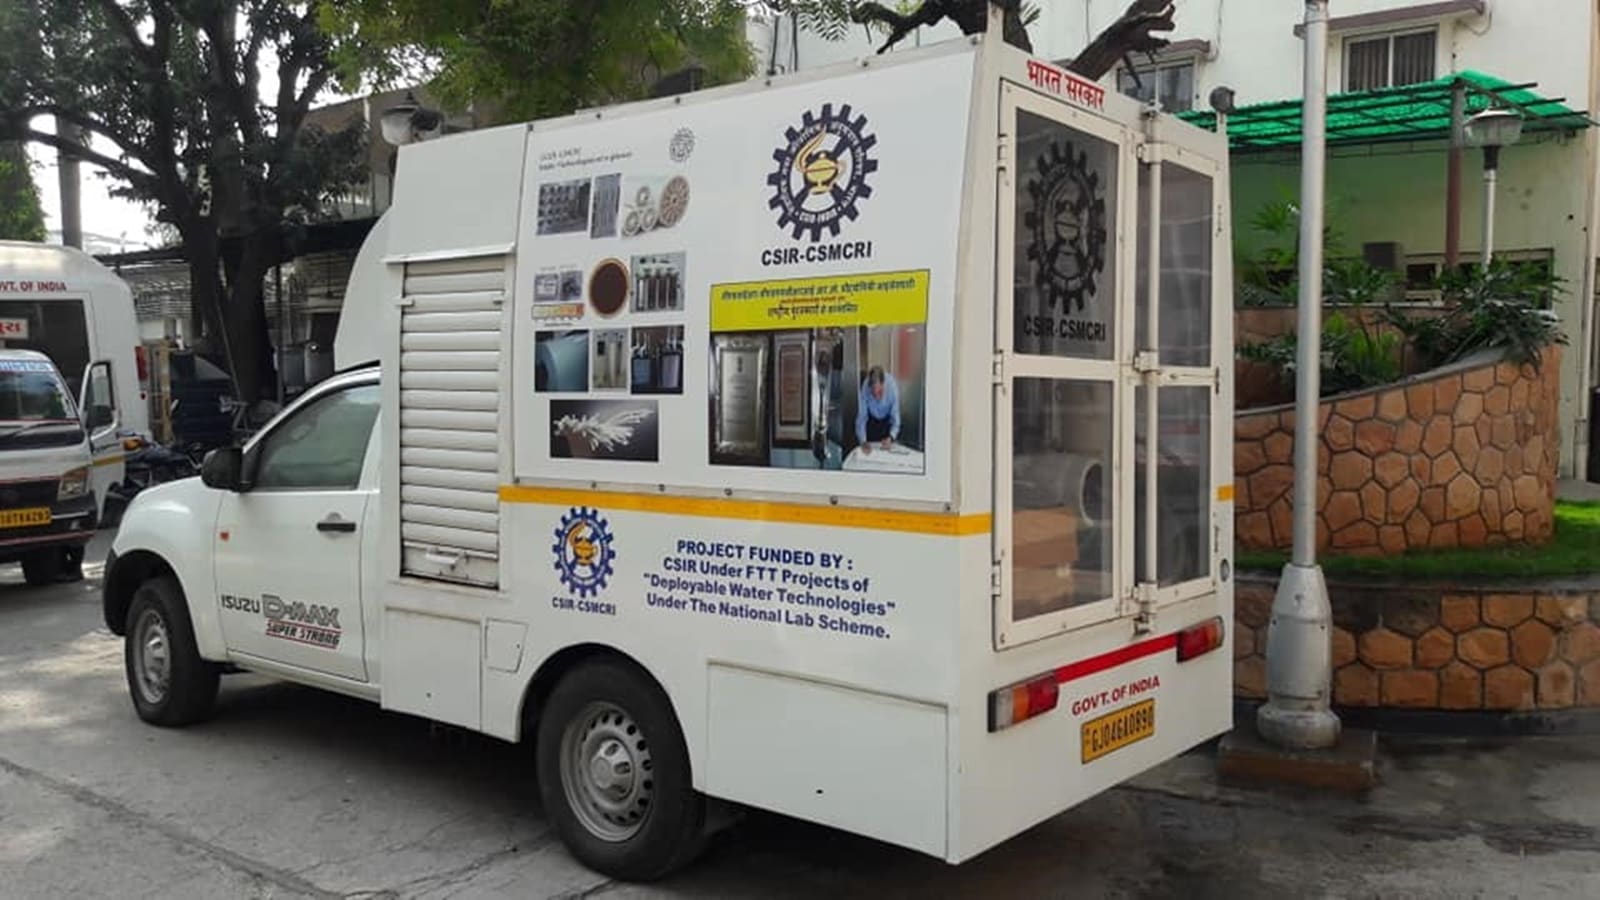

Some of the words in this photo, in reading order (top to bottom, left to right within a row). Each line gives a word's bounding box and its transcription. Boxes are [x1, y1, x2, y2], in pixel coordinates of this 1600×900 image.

[1027, 59, 1061, 94] भारत
[1064, 73, 1105, 113] सरकार
[761, 241, 872, 266] CSIR-CSMCRI
[20, 281, 33, 291] OF
[37, 281, 67, 291] INDIA
[677, 540, 744, 559] PROJECT
[749, 546, 814, 566] FUNDED
[820, 553, 843, 569] BY
[663, 557, 697, 573] CSIR
[700, 560, 743, 578] Under
[746, 565, 778, 582] FTT
[782, 569, 850, 590] Projects
[852, 577, 869, 593] of
[221, 594, 260, 614] ISUZU
[729, 582, 774, 601] Water
[552, 597, 616, 615] CSIR-CSMCRI
[647, 593, 688, 611] Under
[690, 598, 716, 614] The
[719, 601, 782, 624] National
[785, 609, 814, 628] Lab
[818, 614, 891, 639] Scheme.
[266, 621, 297, 637] SUPER
[299, 629, 340, 645] STRONG
[1072, 691, 1110, 716] GOVT.
[1111, 684, 1127, 702] OF
[1128, 675, 1160, 695] INDIA
